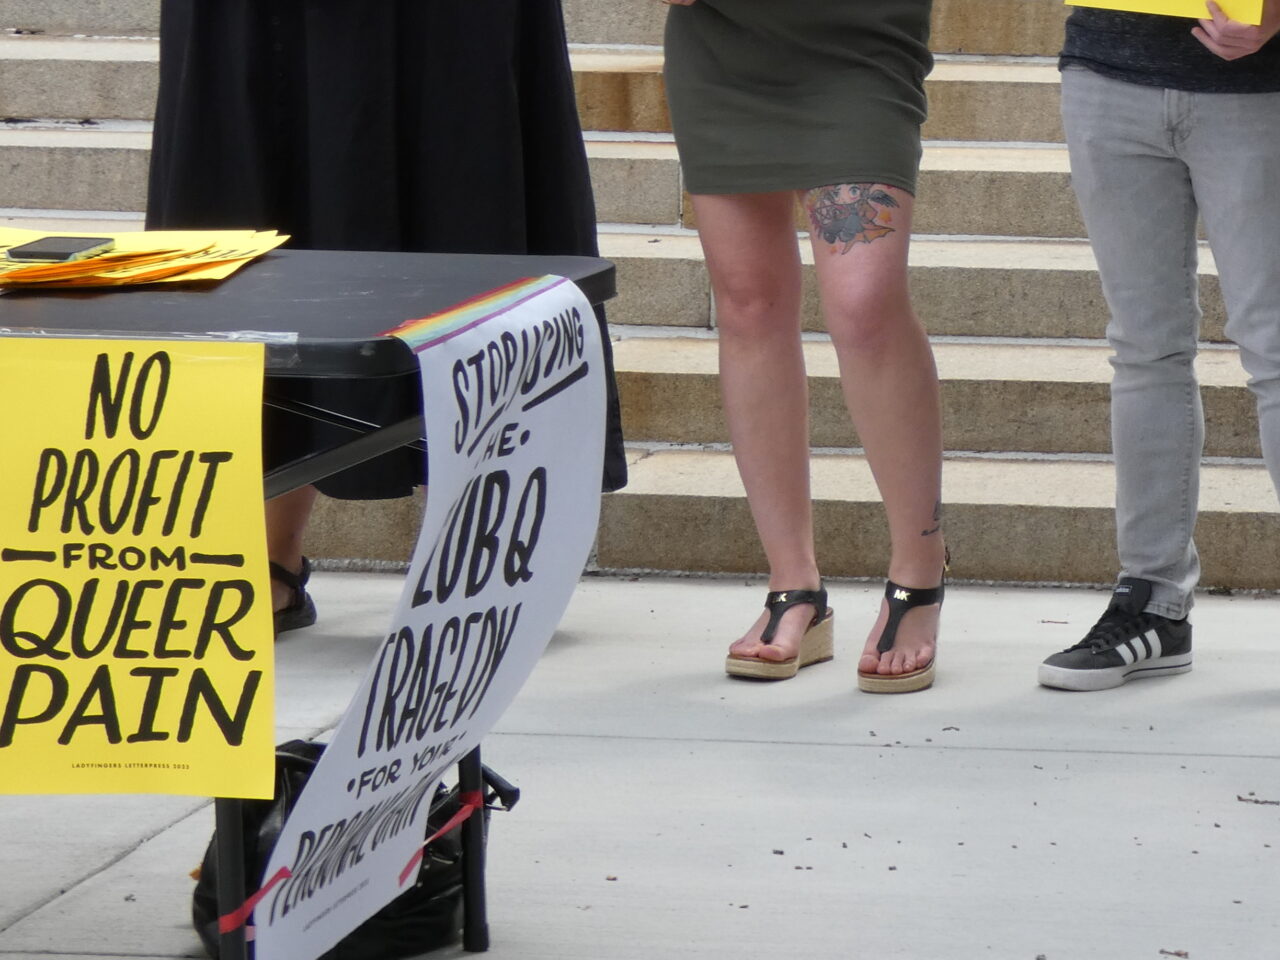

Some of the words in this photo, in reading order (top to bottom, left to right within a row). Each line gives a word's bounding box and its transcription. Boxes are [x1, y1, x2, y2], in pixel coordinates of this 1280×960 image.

[85, 350, 171, 440] NO
[452, 331, 518, 454] STOP
[28, 447, 234, 538] PROFIT
[62, 542, 188, 571] FROM
[411, 469, 511, 609] LUB
[504, 466, 547, 587] Q
[0, 578, 256, 661] QUEER
[0, 663, 263, 747] PAIN
[357, 602, 522, 758] TRAGEDY
[124, 762, 170, 770] LETTERPRESS
[356, 758, 402, 800] FOR
